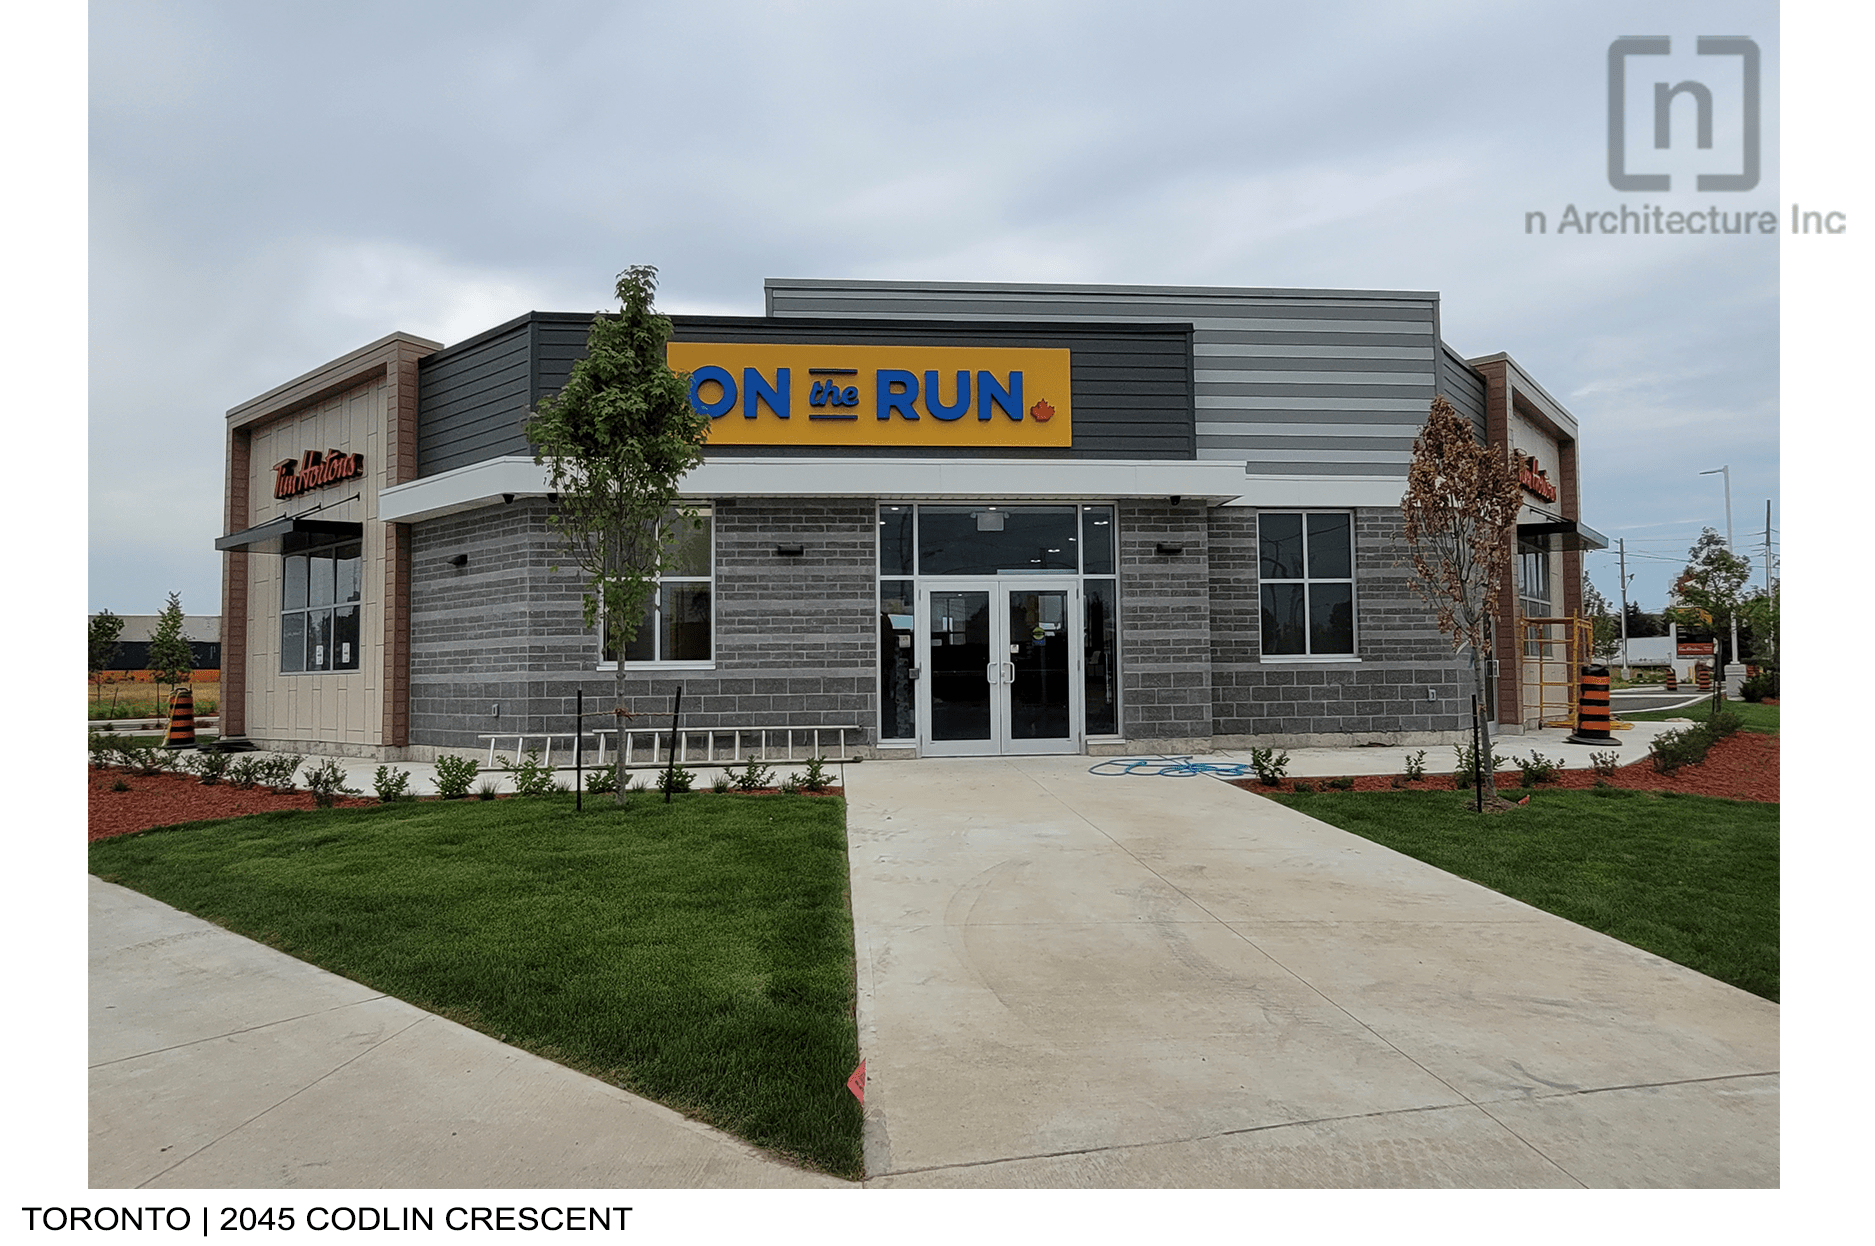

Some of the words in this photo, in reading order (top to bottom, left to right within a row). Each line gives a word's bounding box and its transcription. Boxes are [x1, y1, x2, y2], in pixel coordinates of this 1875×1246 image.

[688, 365, 790, 419] ON
[808, 379, 859, 407] the
[876, 369, 1024, 421] RUN
[272, 458, 298, 499] Tim
[298, 448, 360, 492] Hortons
